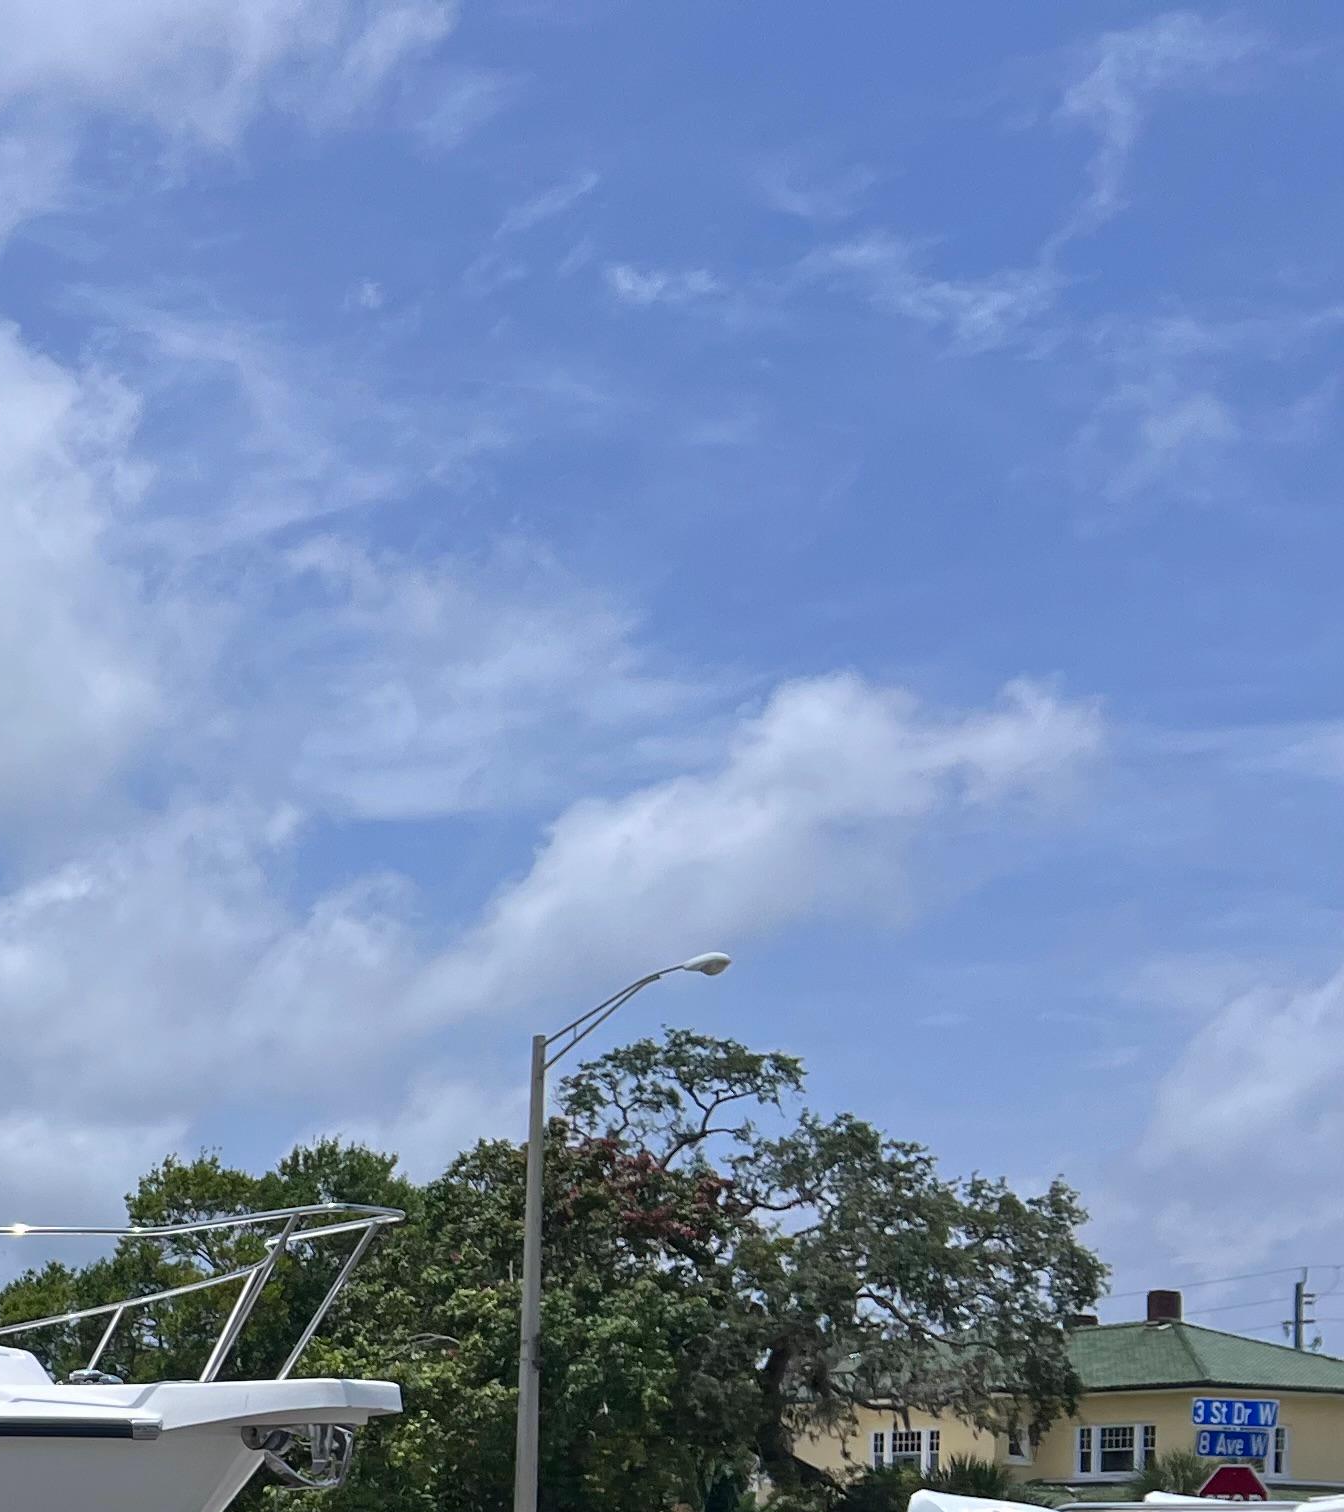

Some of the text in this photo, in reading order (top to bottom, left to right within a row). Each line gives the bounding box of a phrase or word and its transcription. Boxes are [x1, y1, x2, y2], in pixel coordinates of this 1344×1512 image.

[1193, 1400, 1277, 1425] 3 St Dr W
[1198, 1431, 1269, 1456] 8 Ave W
